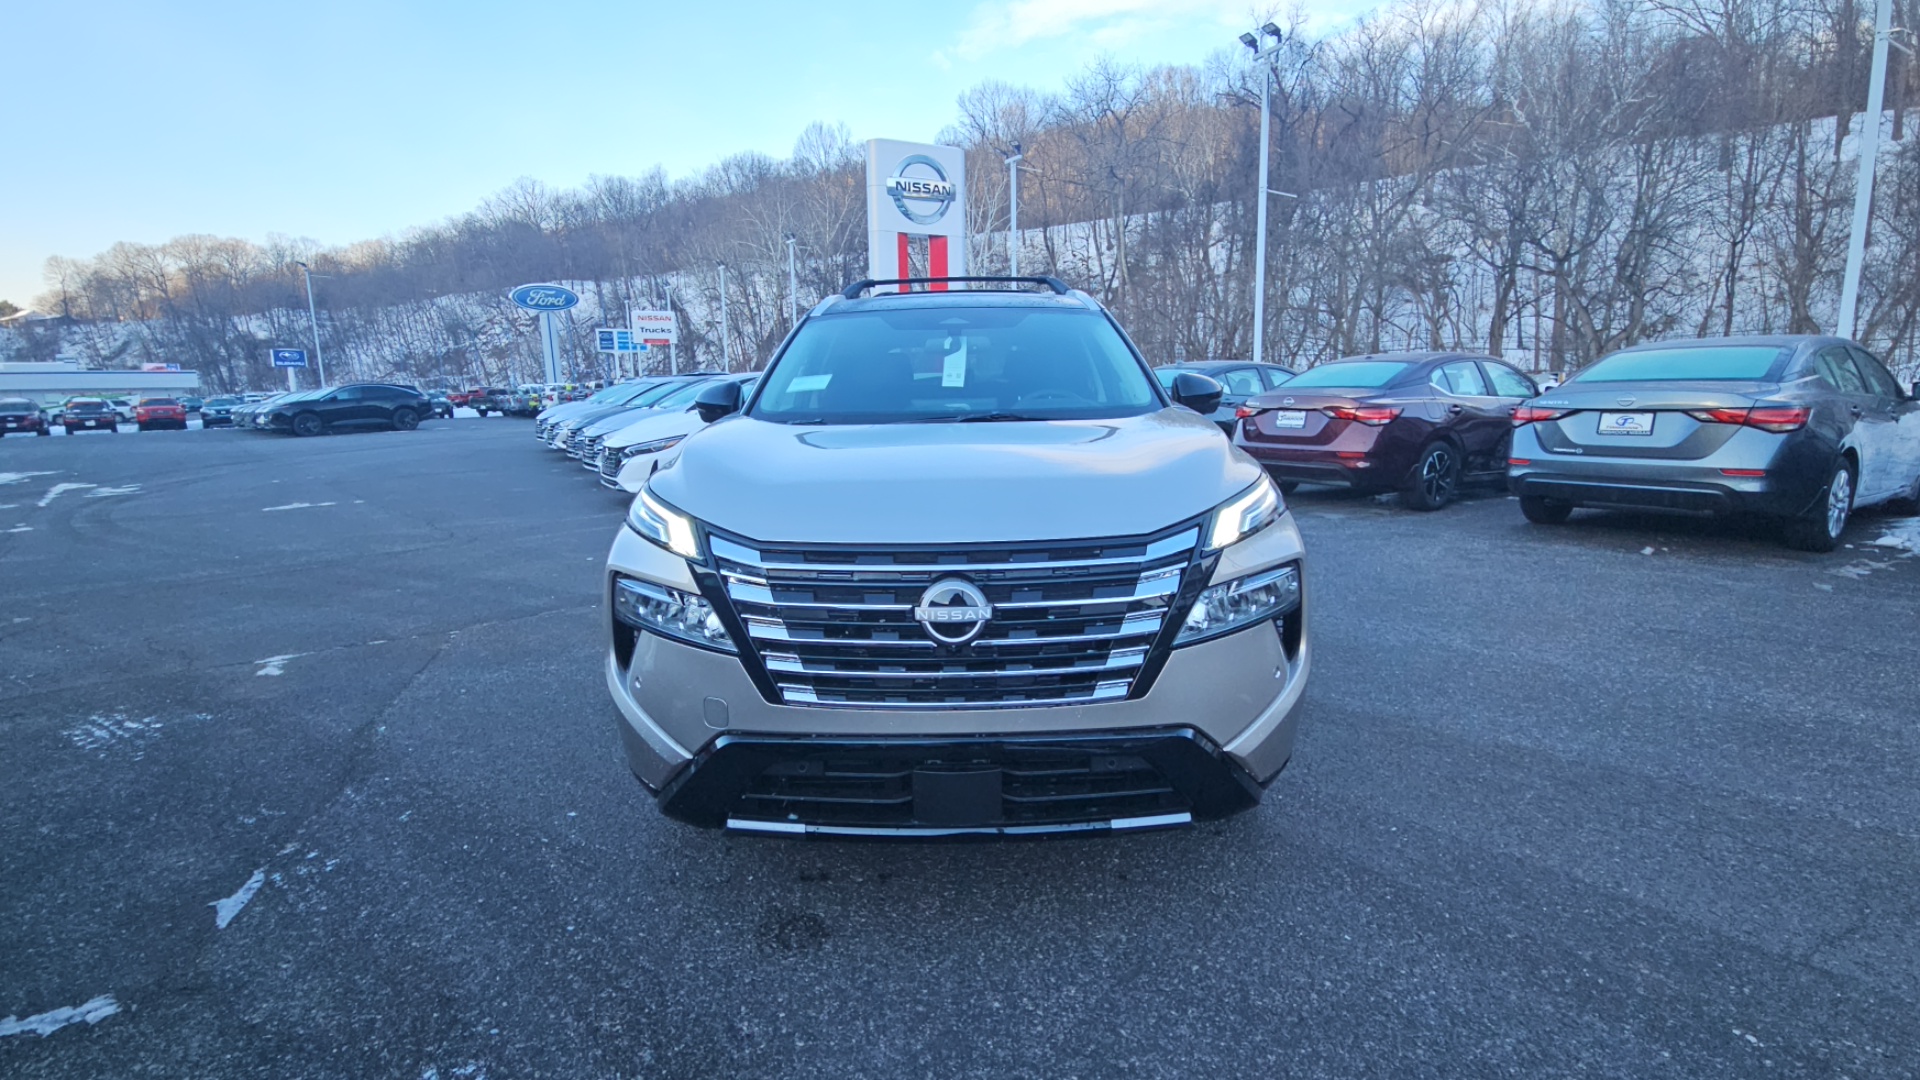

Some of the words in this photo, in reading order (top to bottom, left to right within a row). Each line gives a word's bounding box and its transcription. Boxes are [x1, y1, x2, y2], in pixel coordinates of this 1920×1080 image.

[895, 181, 951, 196] NISSAN
[526, 289, 566, 306] Ford
[916, 608, 991, 620] NISSAN
